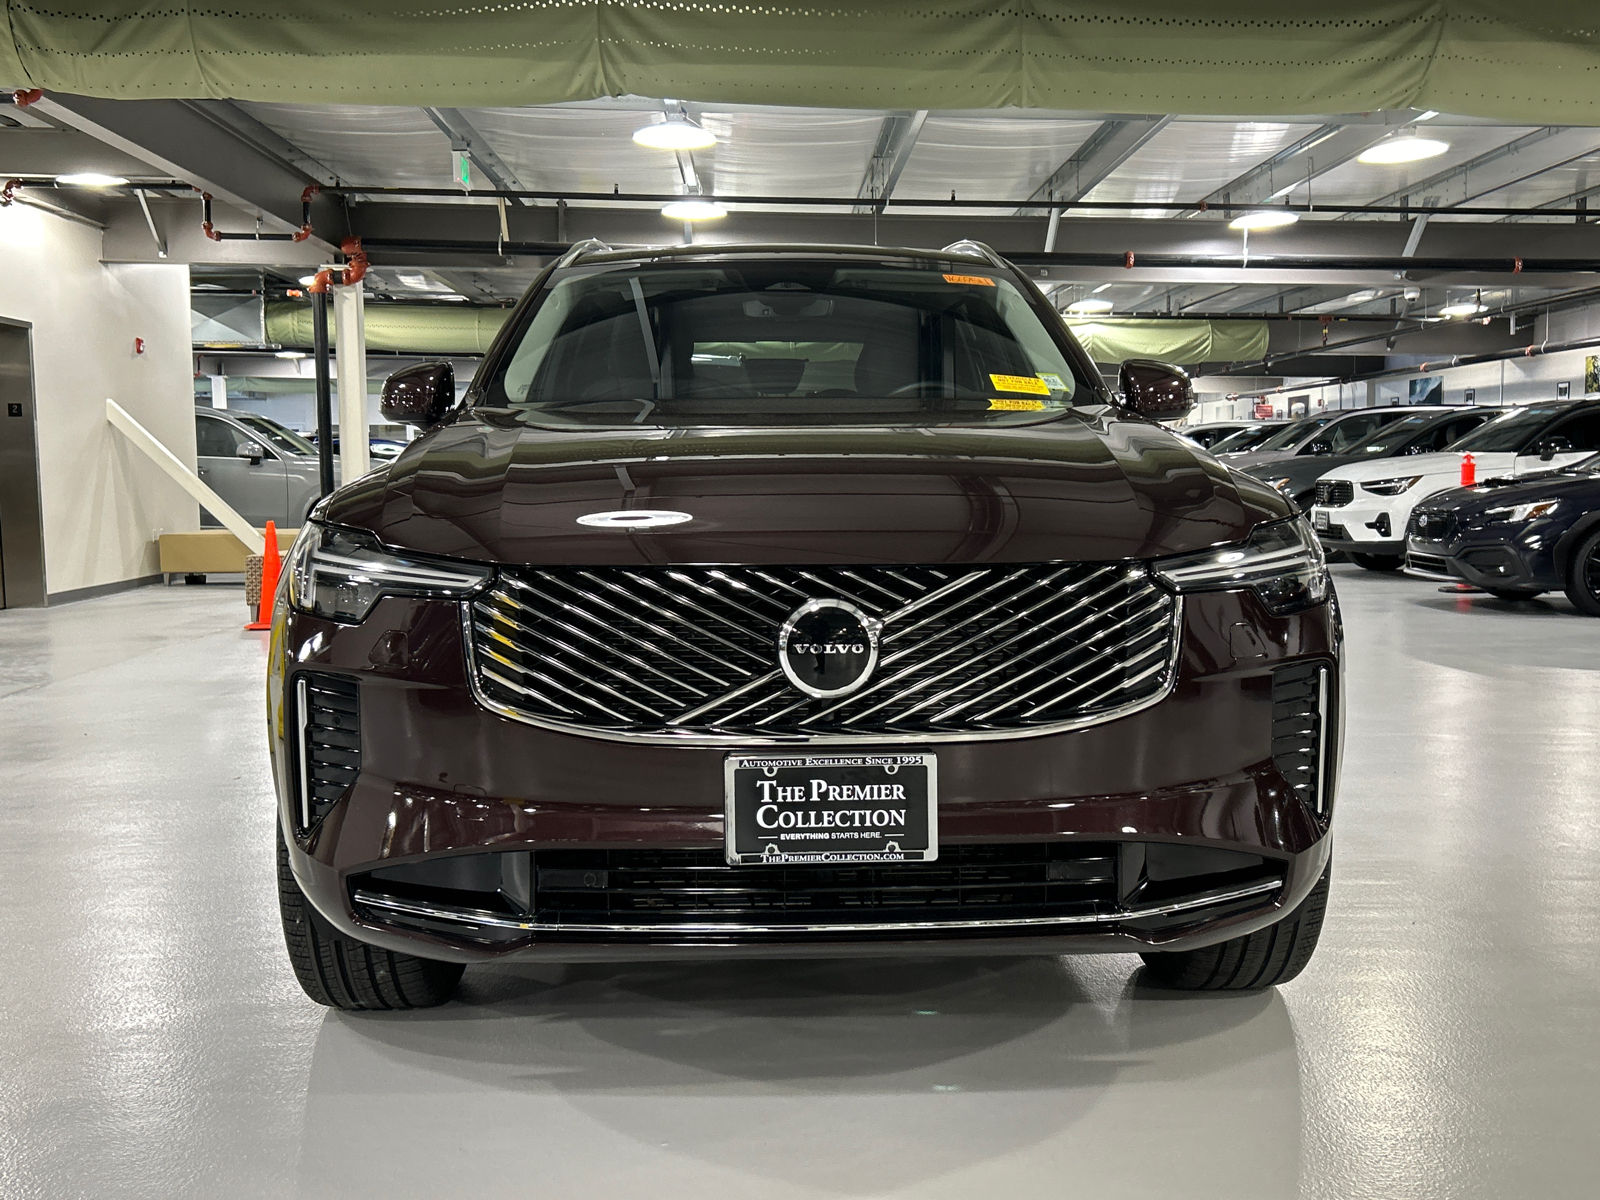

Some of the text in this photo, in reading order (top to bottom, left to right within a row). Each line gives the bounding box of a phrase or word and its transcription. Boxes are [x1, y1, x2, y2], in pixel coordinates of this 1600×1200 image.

[12, 404, 18, 414] 2
[793, 643, 864, 654] VOLVO
[741, 759, 803, 767] AUTOMOTIVE
[865, 757, 893, 765] SINCE
[896, 756, 922, 764] 1995
[756, 779, 906, 803] THE PREMIER
[756, 805, 906, 829] COLLECTION
[780, 832, 829, 840] EVERYTHING
[831, 832, 859, 840] STARTS
[760, 853, 905, 863] THEPREMIERCOLLECTION.COM
